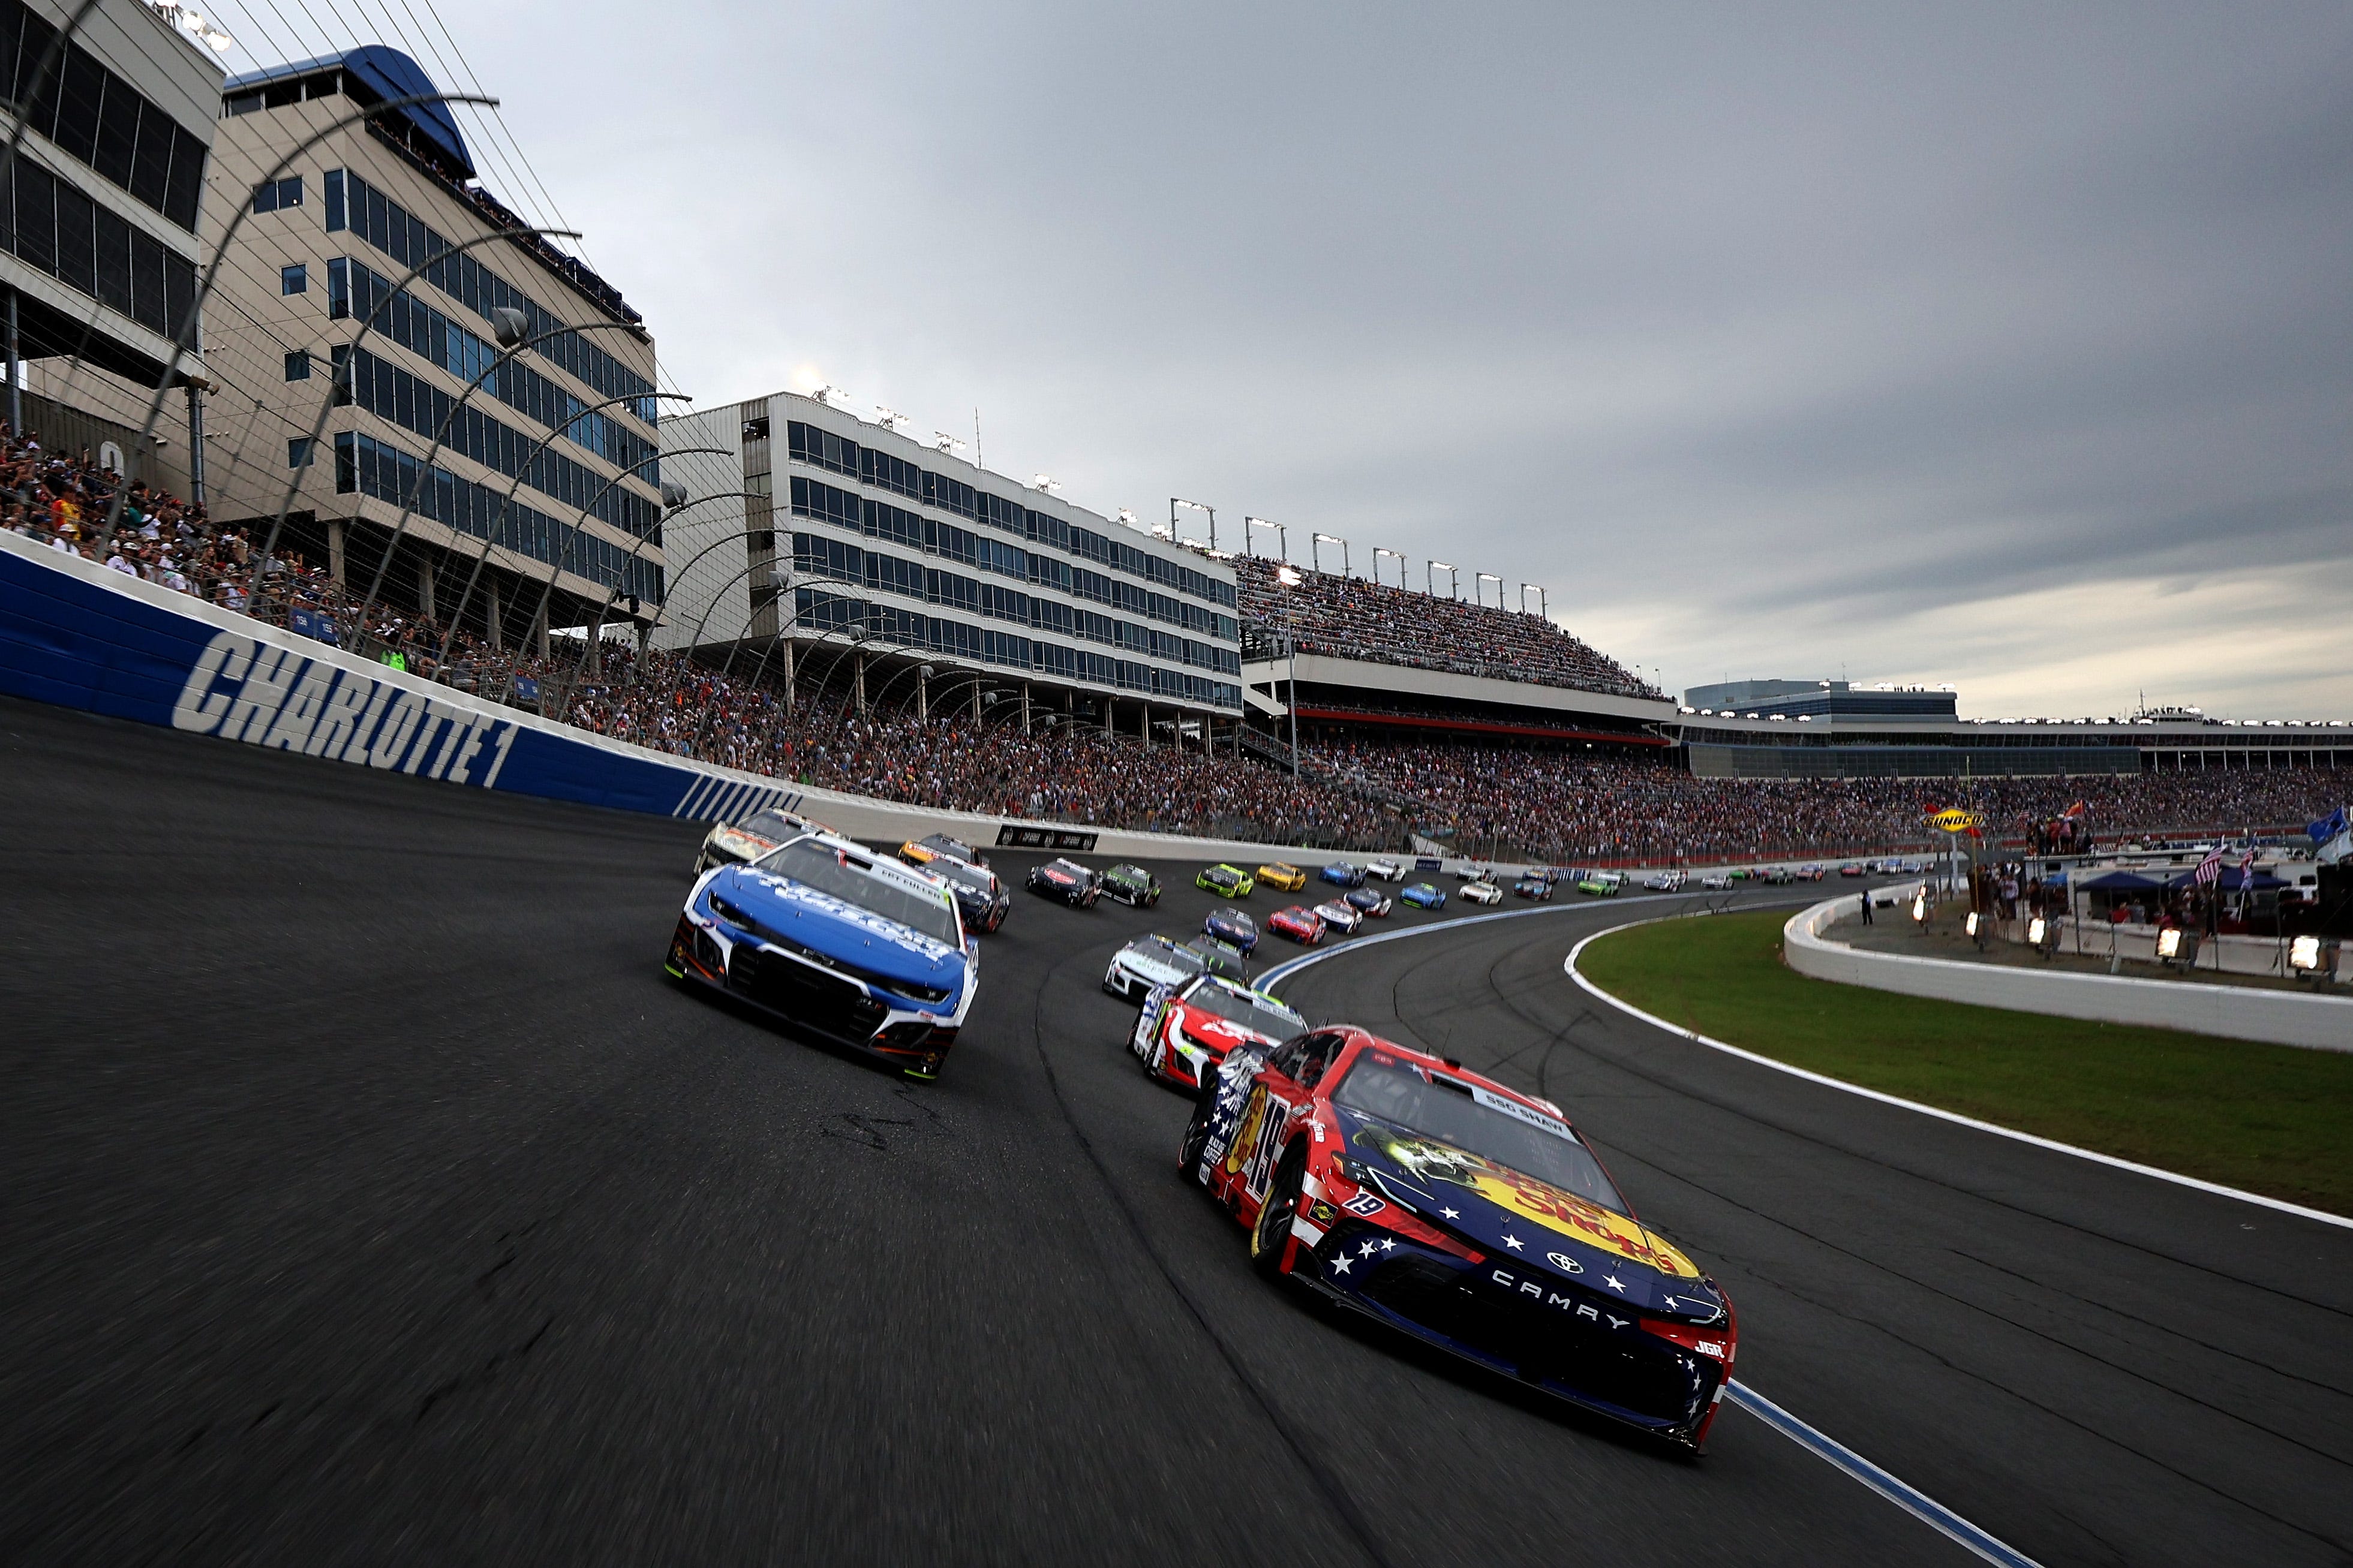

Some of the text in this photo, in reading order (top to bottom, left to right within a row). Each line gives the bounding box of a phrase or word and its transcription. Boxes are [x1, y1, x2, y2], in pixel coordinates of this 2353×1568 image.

[172, 631, 496, 784] CHARLOTTE
[1923, 813, 1984, 828] SUNOCO
[1486, 1094, 1563, 1133] SSG SHAW
[1204, 1144, 1221, 1164] COFFEE
[1247, 1097, 1288, 1202] 19
[1342, 1192, 1386, 1217] 19
[1514, 1189, 1679, 1275] Shops
[1492, 1269, 1630, 1329] CAMRY
[1694, 1340, 1723, 1357] JGR
